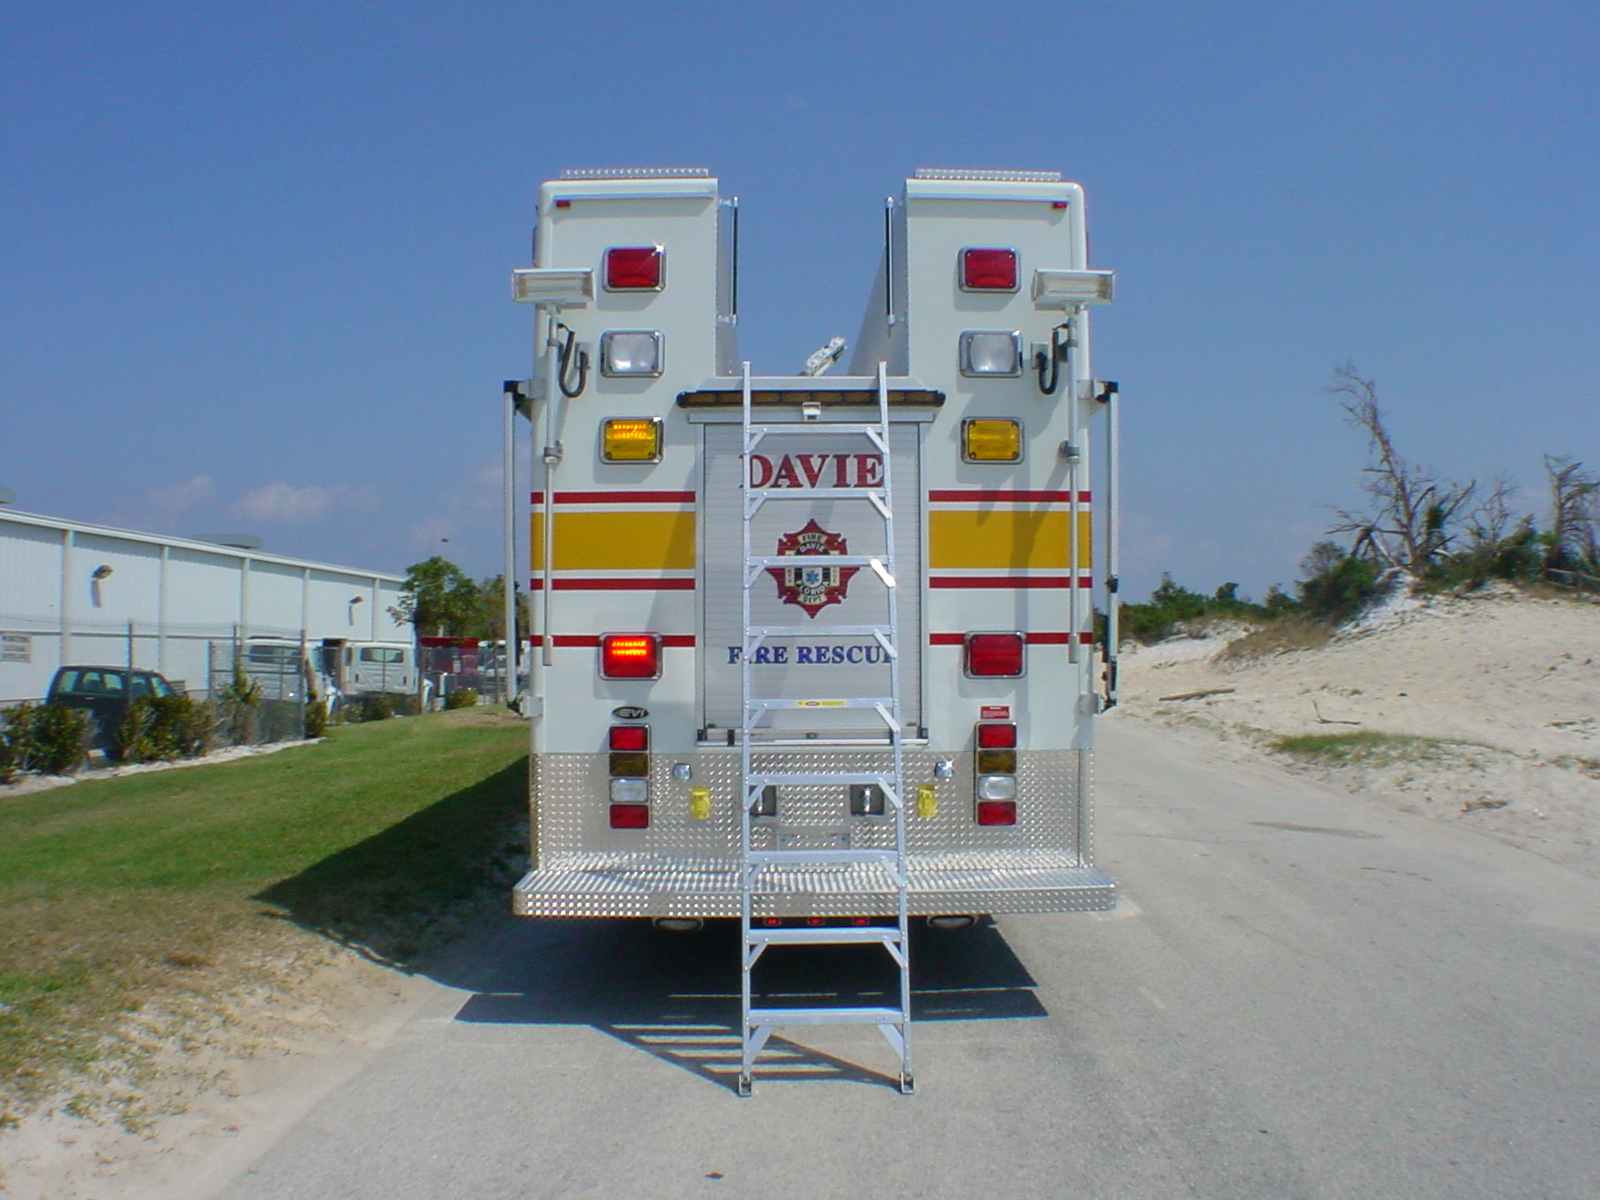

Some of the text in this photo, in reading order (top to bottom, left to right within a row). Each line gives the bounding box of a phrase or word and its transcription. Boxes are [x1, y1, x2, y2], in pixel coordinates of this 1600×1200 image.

[739, 454, 884, 489] DAVIE
[802, 533, 823, 542] FIRE
[799, 541, 827, 553] DAVIE
[795, 580, 830, 596] FLORIDA
[803, 596, 823, 604] DEPT
[727, 646, 789, 664] FRE
